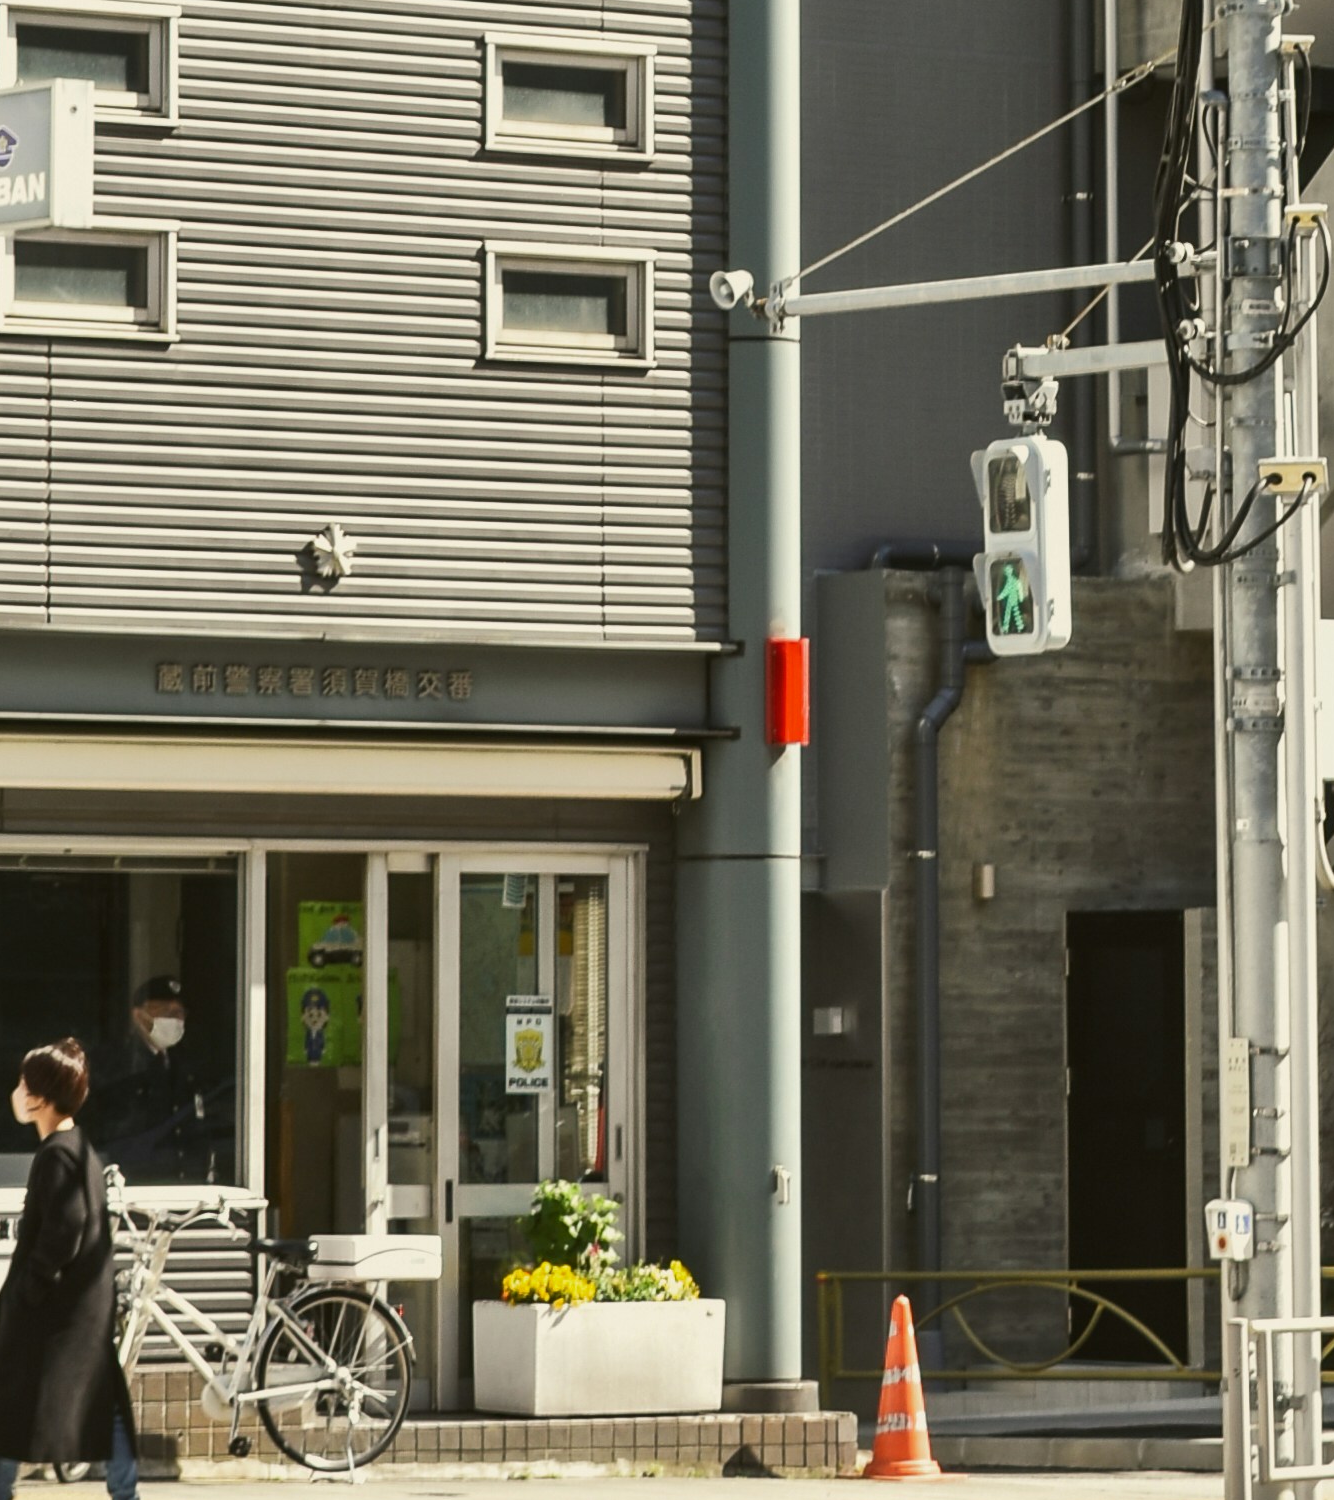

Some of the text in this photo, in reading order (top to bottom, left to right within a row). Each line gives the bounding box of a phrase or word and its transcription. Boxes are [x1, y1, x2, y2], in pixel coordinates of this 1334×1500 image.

[156, 663, 474, 700] 蔵前警察署須賀橋交番
[509, 1077, 549, 1088] POLICE
